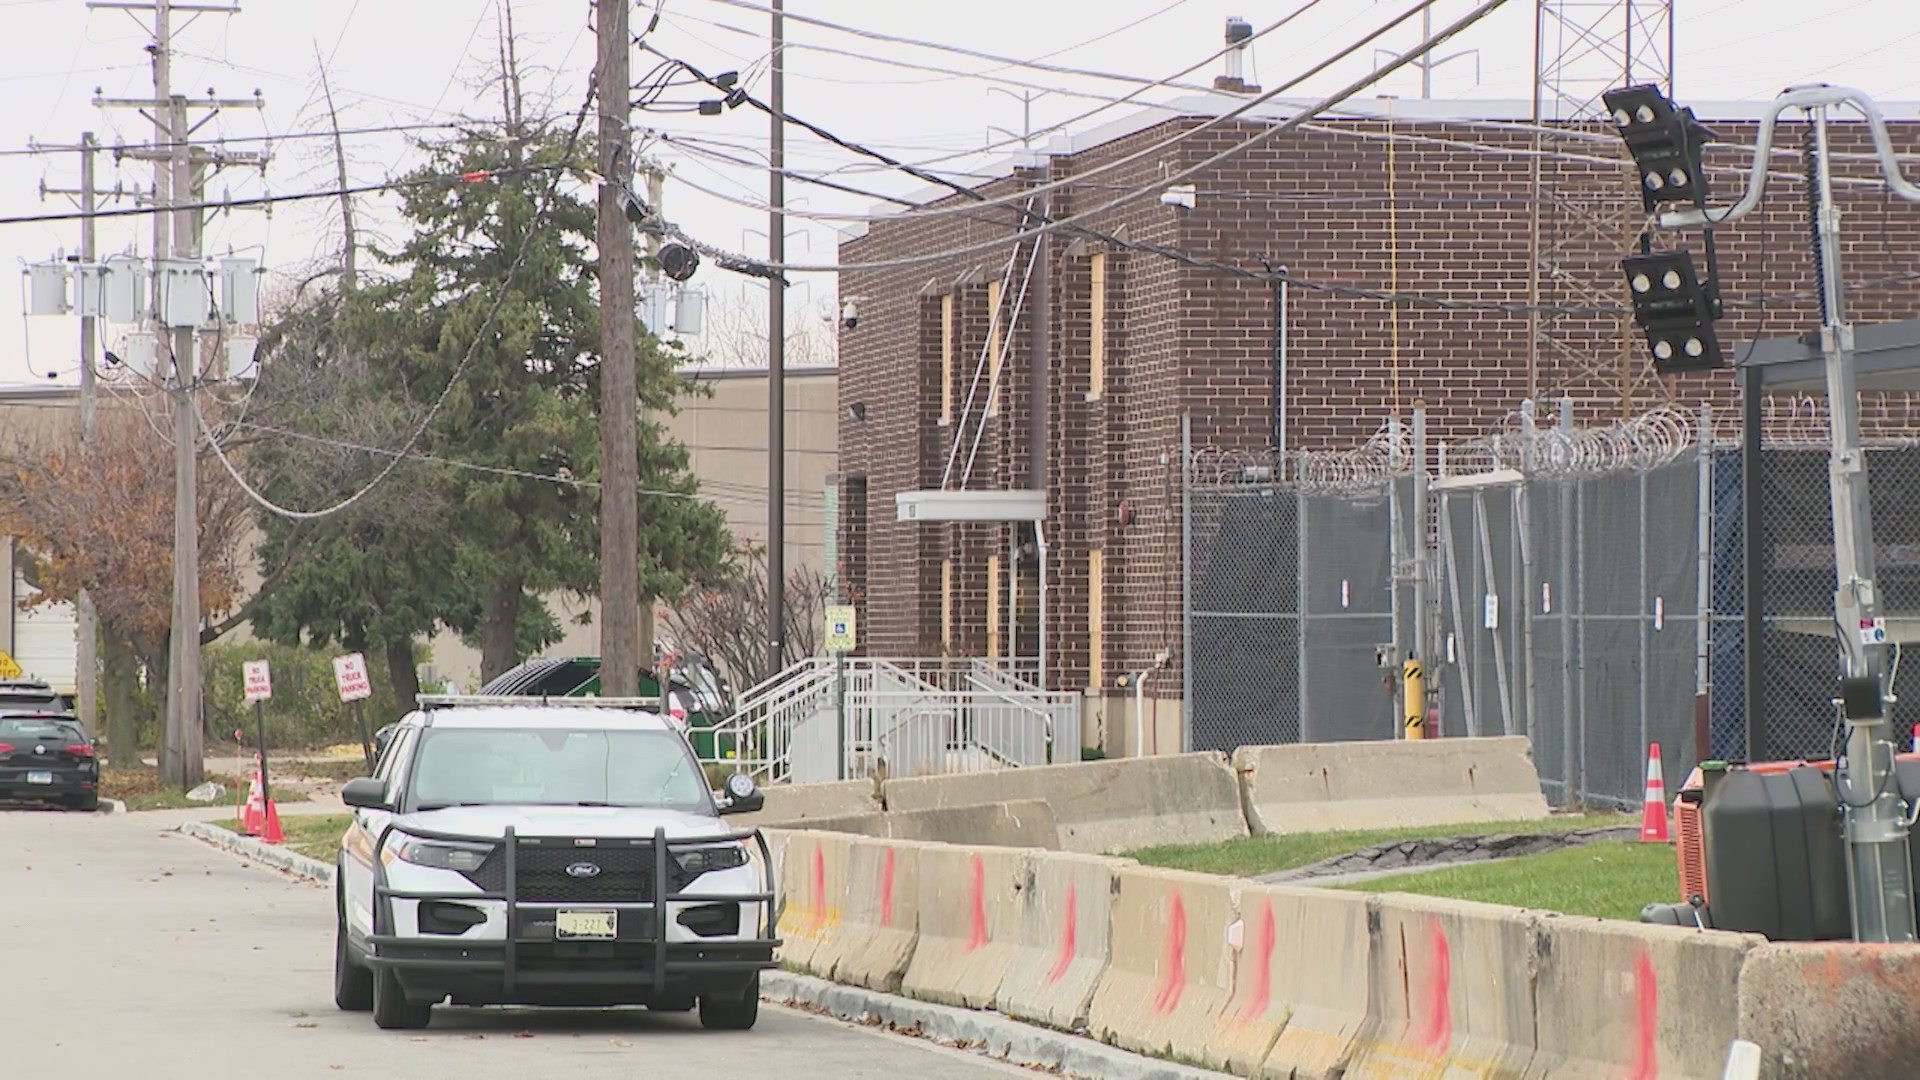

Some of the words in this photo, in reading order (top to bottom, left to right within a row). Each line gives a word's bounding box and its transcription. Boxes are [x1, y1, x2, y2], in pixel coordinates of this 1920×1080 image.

[248, 675, 266, 684] TRUCK
[341, 671, 361, 682] TRUCK
[246, 685, 269, 694] PARKING
[341, 682, 369, 693] PARKING
